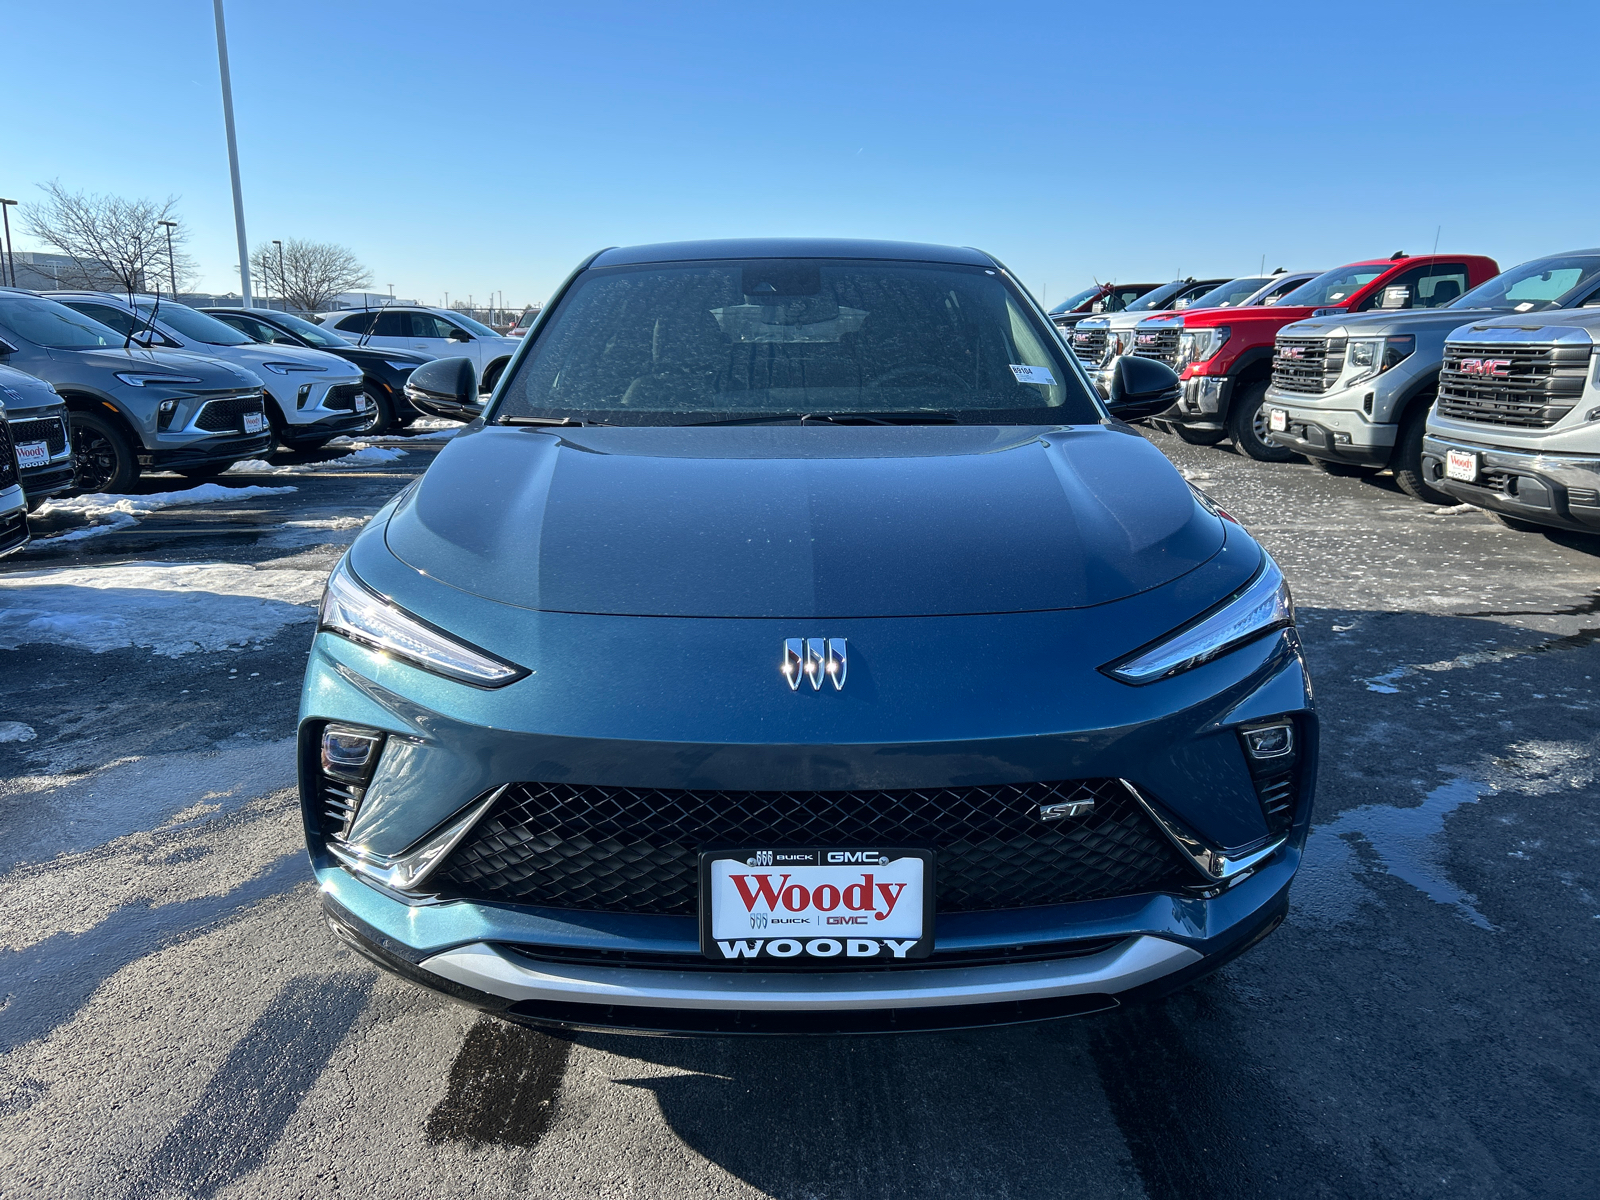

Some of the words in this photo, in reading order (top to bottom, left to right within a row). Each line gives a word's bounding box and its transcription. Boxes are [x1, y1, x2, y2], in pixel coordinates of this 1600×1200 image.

[1460, 358, 1512, 376] GMC
[16, 446, 45, 457] Woody
[1450, 454, 1473, 469] Woody
[827, 851, 879, 863] GMC
[728, 873, 908, 921] Woody
[826, 915, 868, 925] GMC
[717, 938, 918, 959] WOODY
